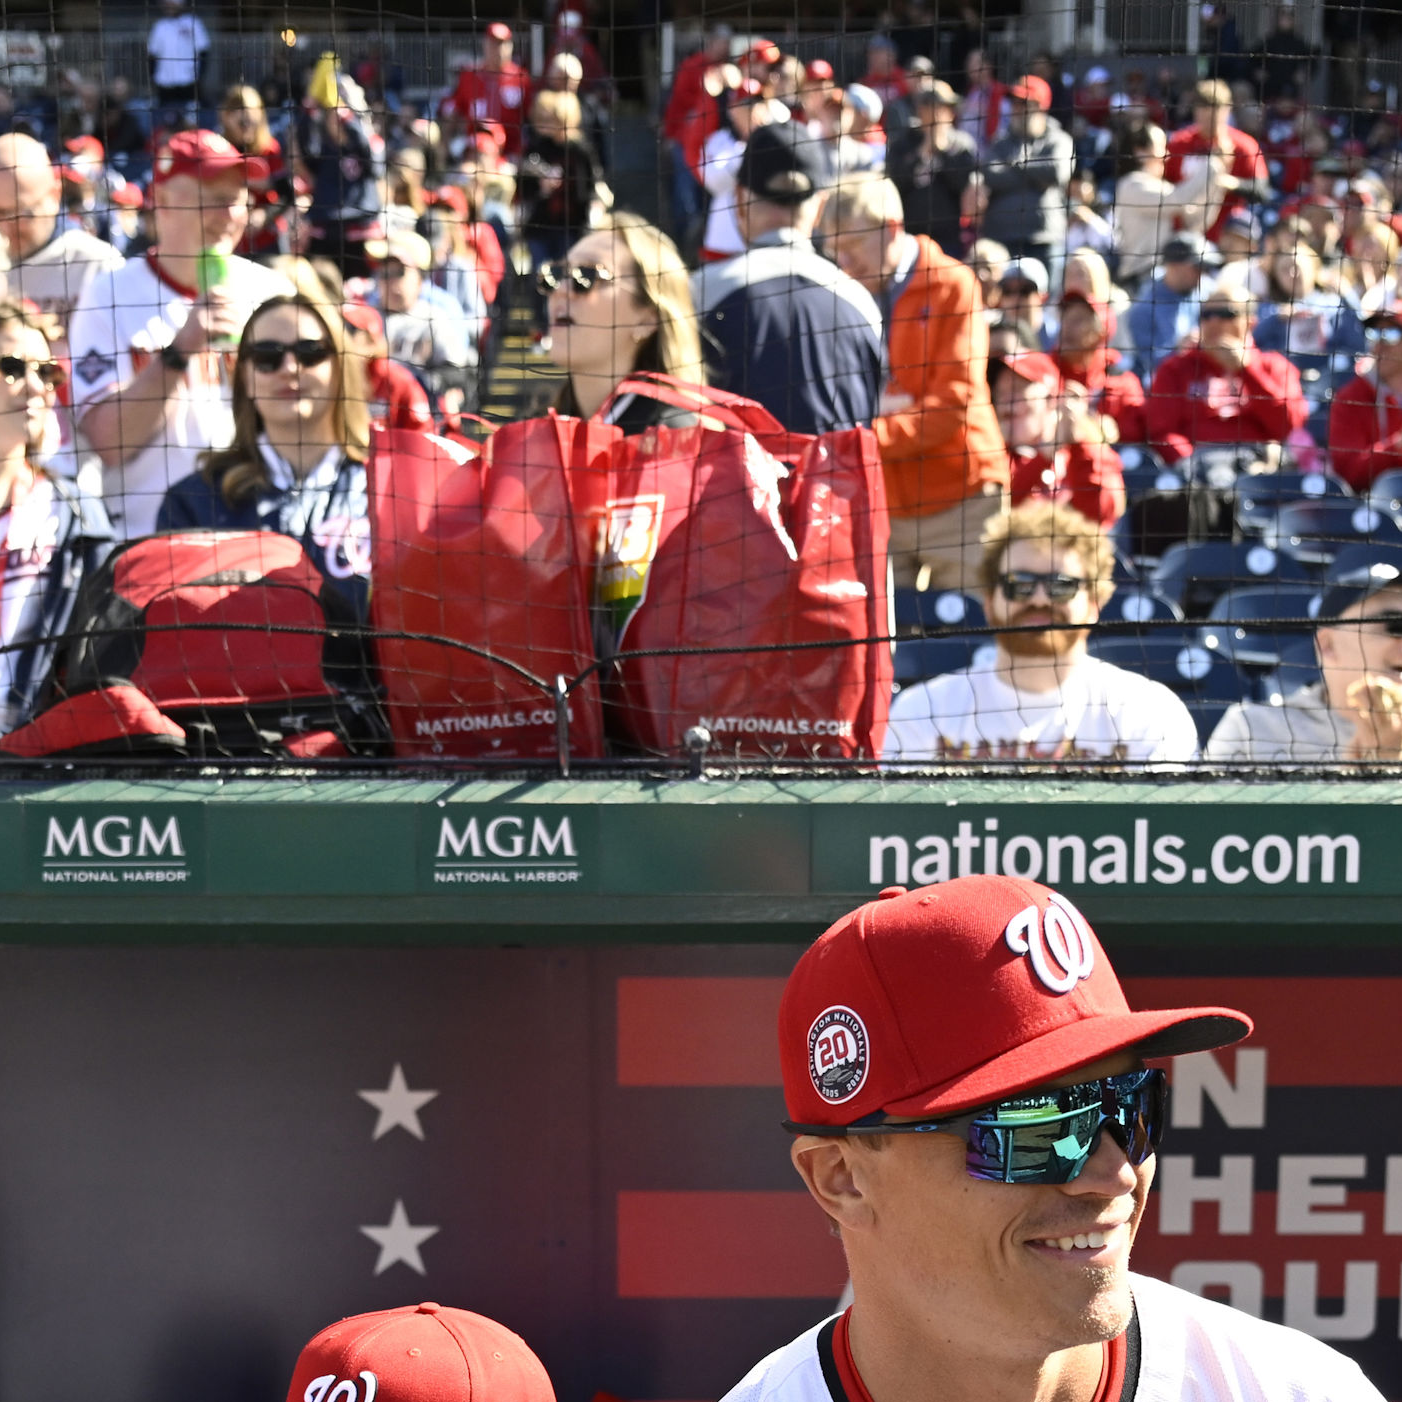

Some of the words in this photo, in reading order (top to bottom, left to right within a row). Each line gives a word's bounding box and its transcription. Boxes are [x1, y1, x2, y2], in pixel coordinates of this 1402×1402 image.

[43, 815, 186, 857] MGM
[435, 816, 578, 857] MGM
[870, 819, 1360, 884] nationals.com
[42, 871, 118, 882] NATIONAL
[434, 871, 510, 883] NATIONAL
[808, 1014, 831, 1088] WASHINGTON
[834, 1012, 865, 1062] NATIONALS
[818, 1029, 849, 1068] 20
[1171, 1048, 1267, 1129] N
